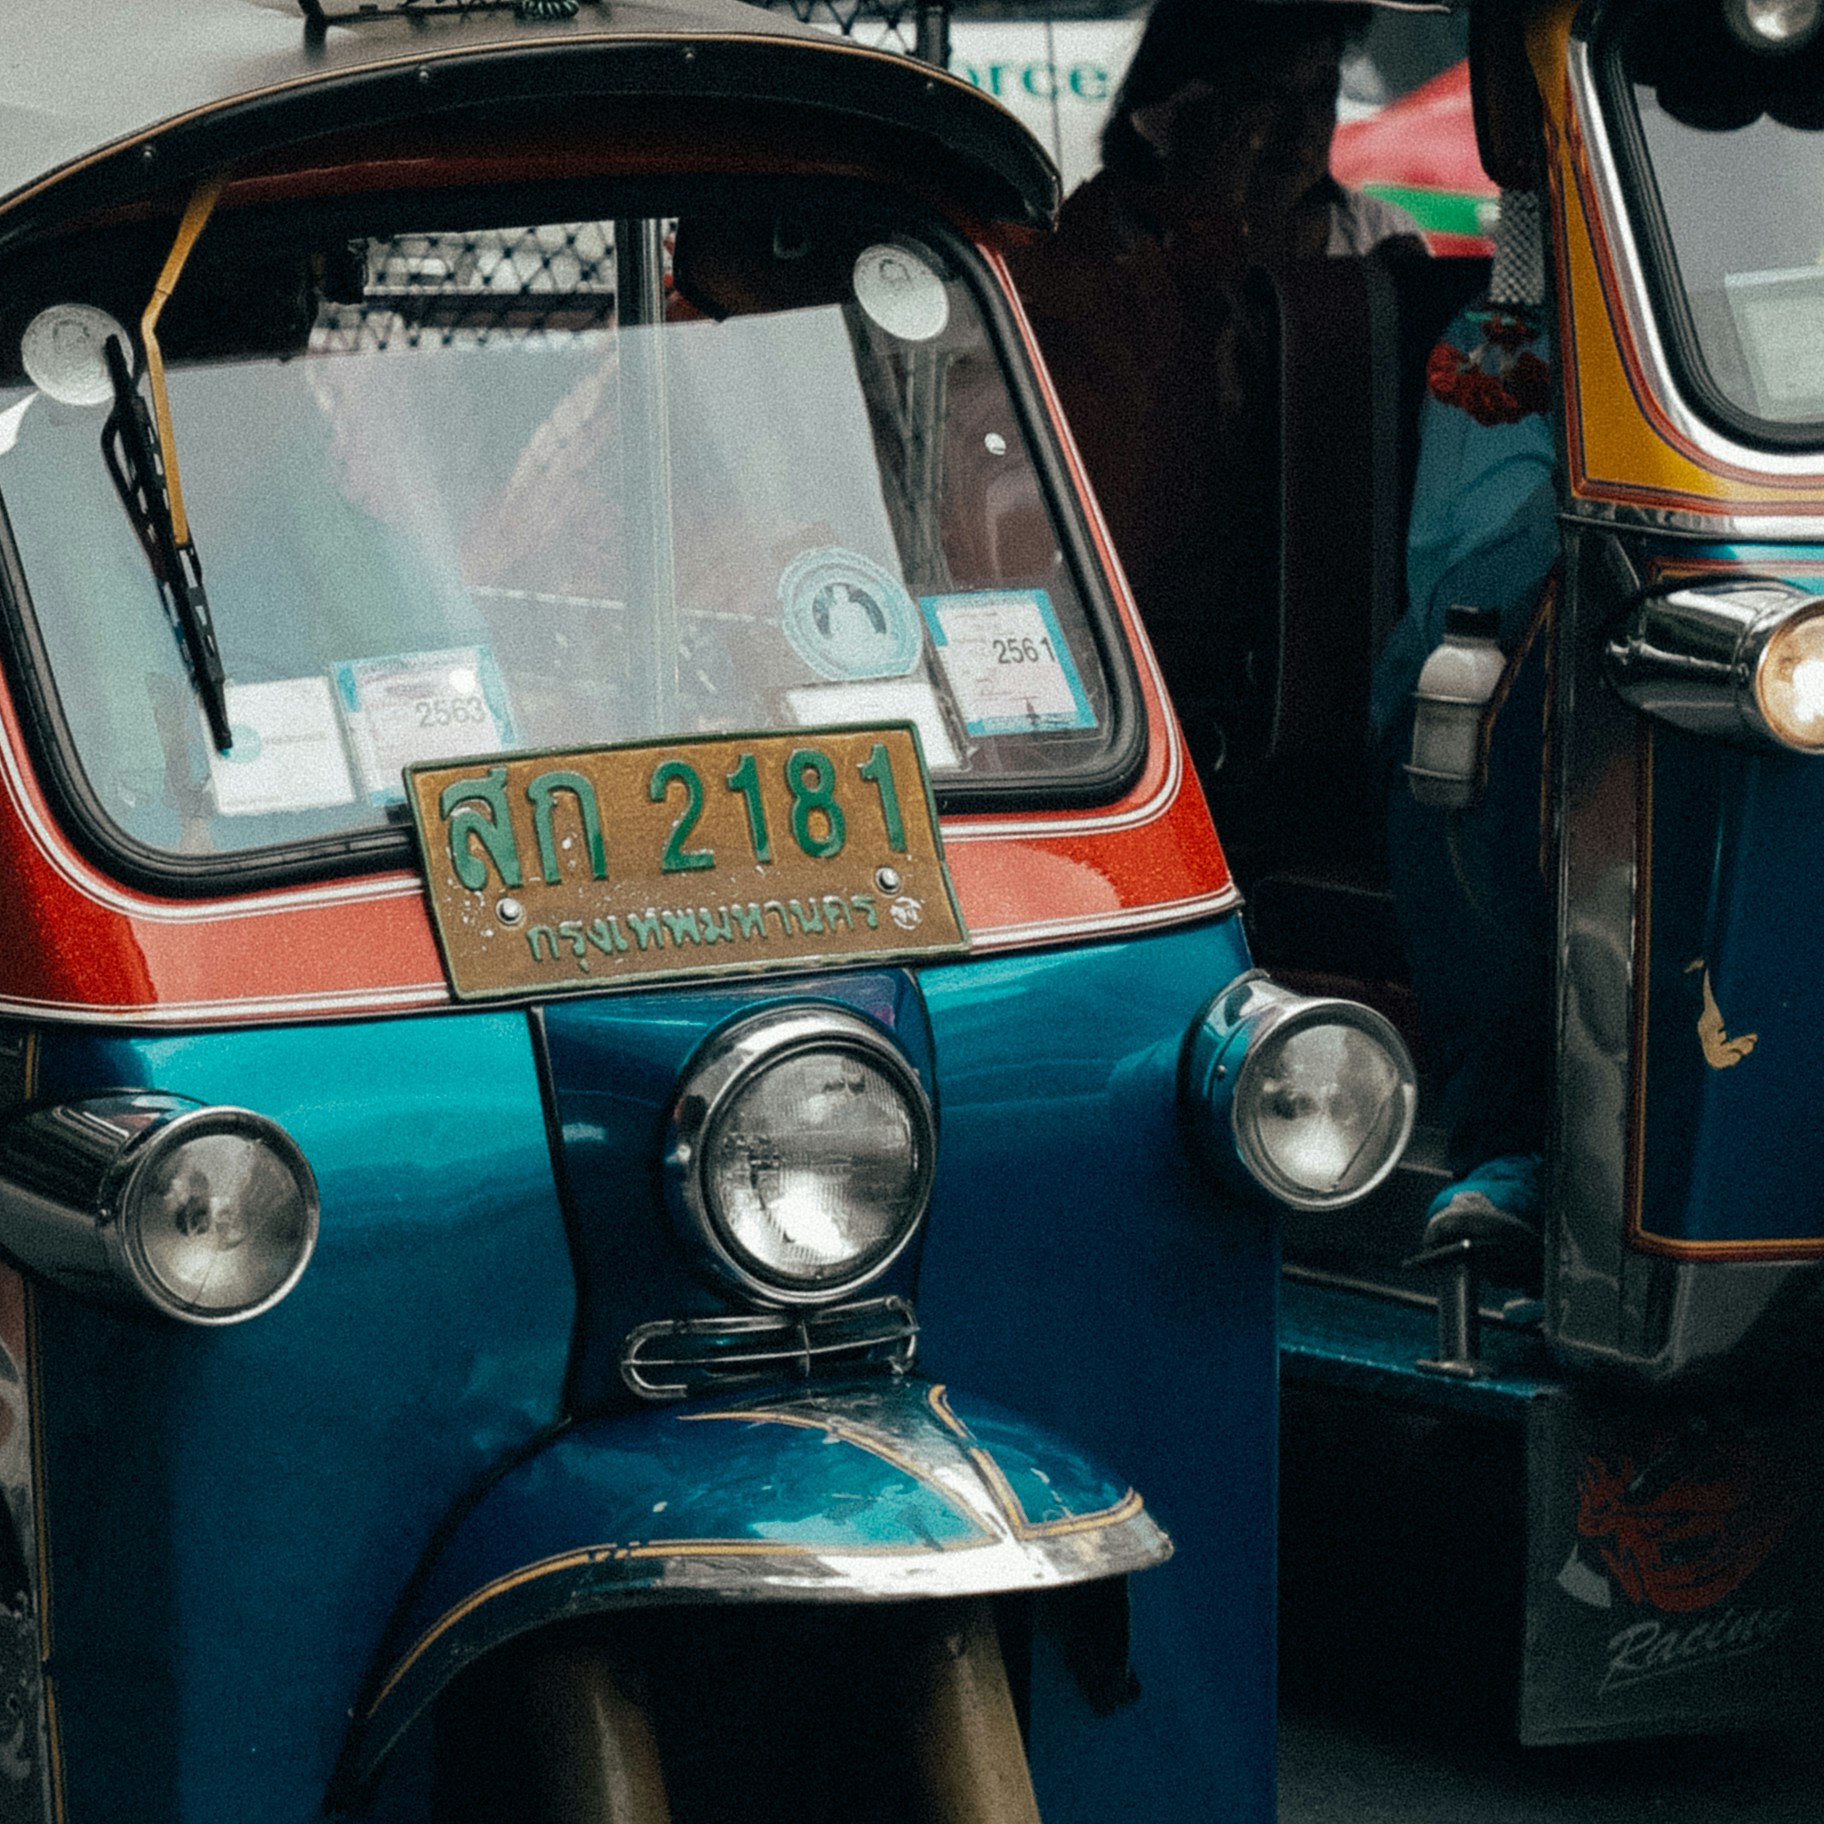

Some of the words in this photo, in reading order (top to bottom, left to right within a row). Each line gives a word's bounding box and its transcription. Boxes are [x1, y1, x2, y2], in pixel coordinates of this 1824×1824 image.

[967, 59, 1110, 103] rce
[992, 636, 1057, 666] 2561
[415, 696, 487, 728] 2563
[439, 766, 609, 894] สก
[649, 742, 908, 874] 2181
[526, 893, 880, 973] กรุงเทพมหานคร
